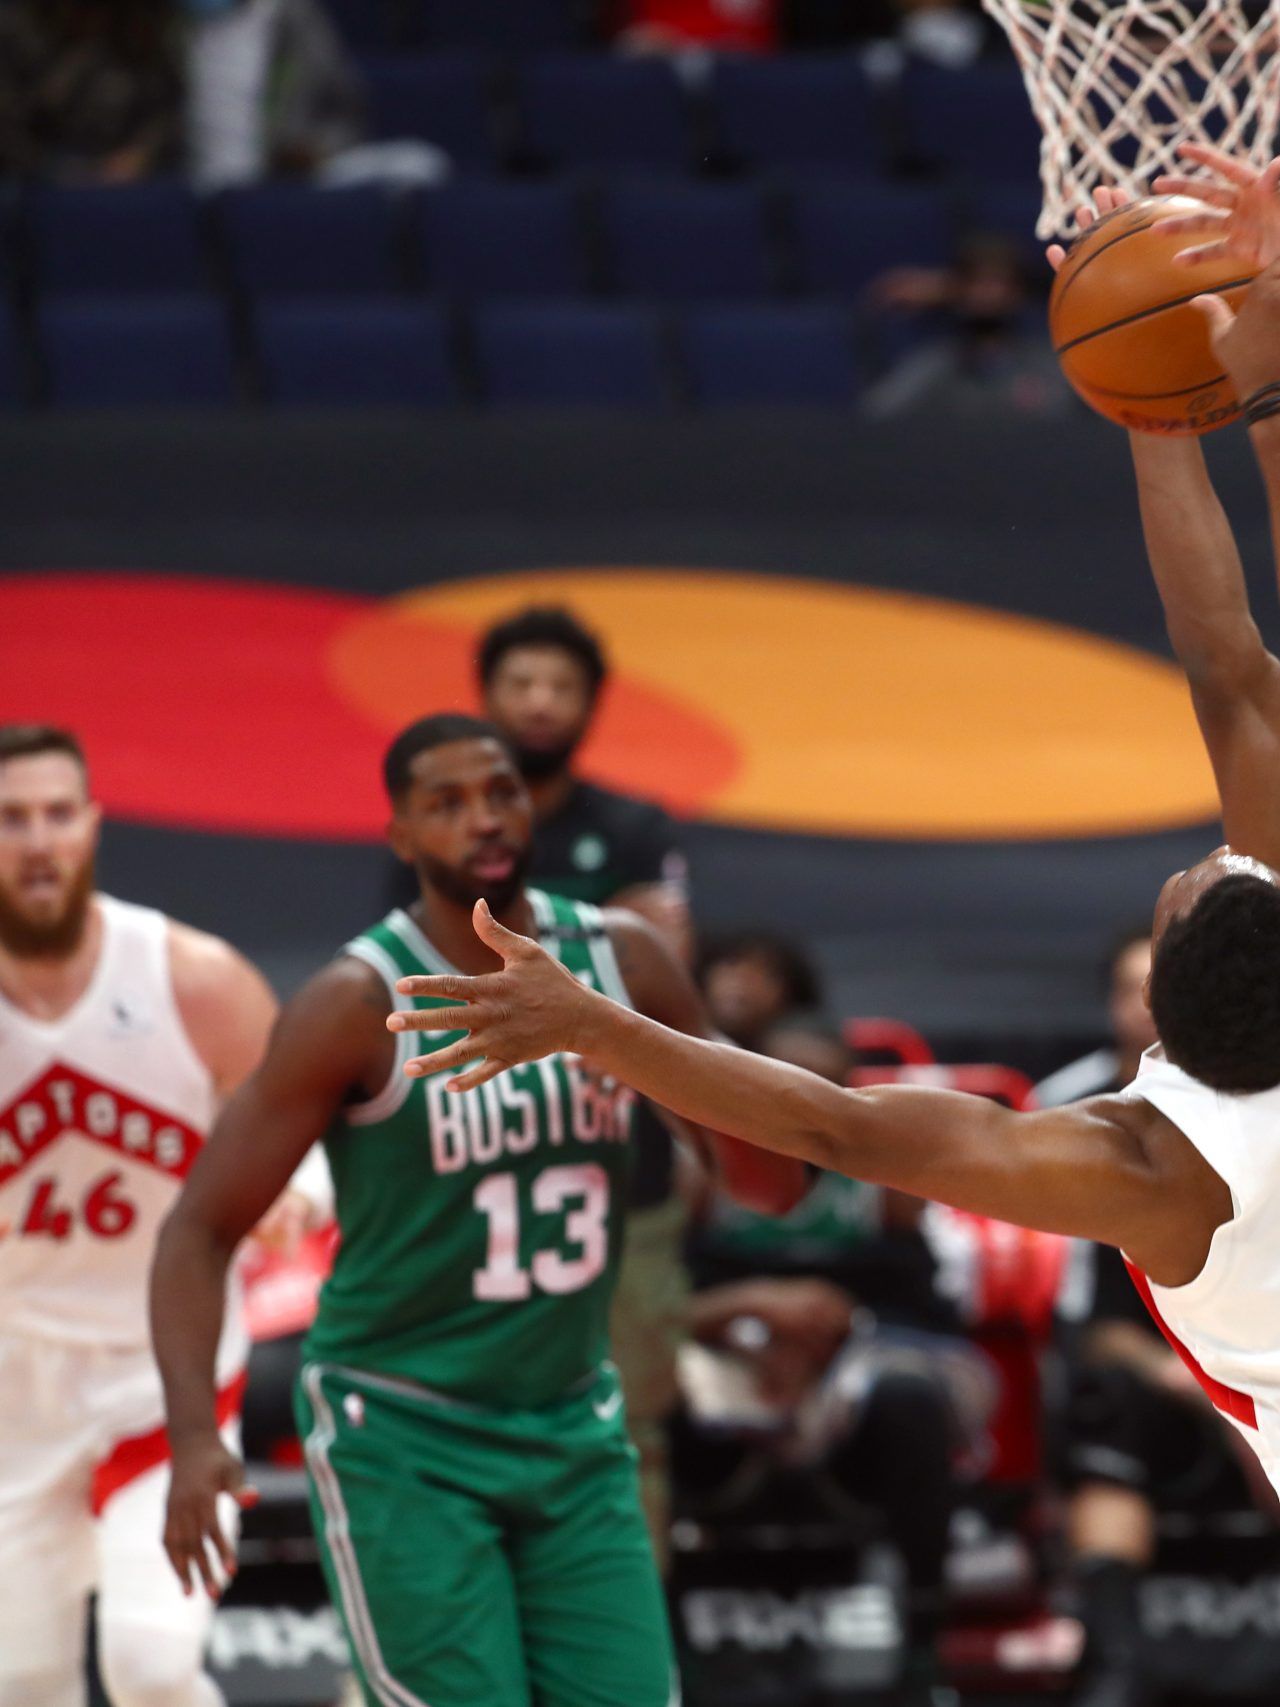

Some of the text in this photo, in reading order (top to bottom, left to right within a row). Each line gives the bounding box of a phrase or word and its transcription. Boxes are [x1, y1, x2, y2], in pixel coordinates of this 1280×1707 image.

[0, 1078, 186, 1168] APTORS
[18, 1167, 138, 1242] 46
[472, 1161, 610, 1301] 13
